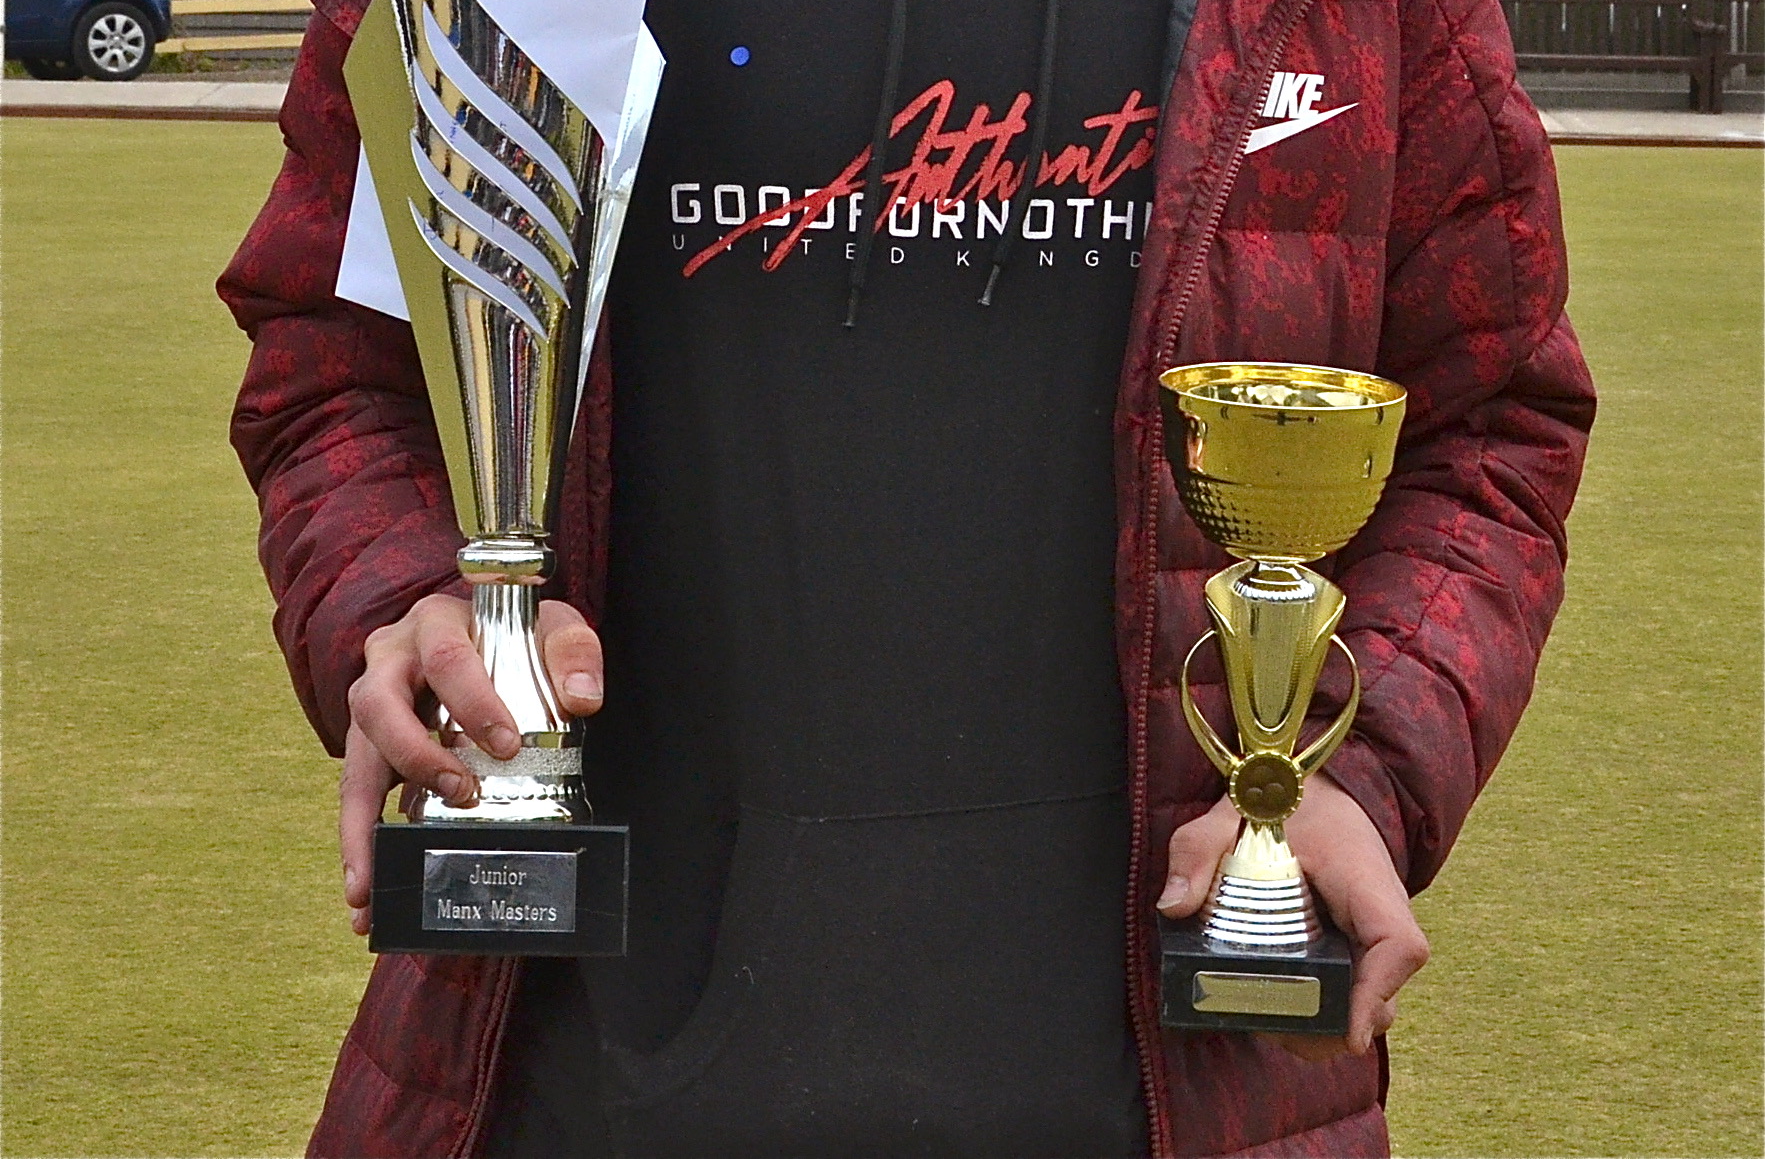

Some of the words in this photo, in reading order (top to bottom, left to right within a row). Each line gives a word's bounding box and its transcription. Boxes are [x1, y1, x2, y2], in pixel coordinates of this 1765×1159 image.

[1261, 72, 1325, 119] IKE
[956, 249, 1142, 268] KNGD
[469, 864, 527, 886] Junior
[437, 898, 482, 920] Manx
[491, 899, 557, 922] Masters
